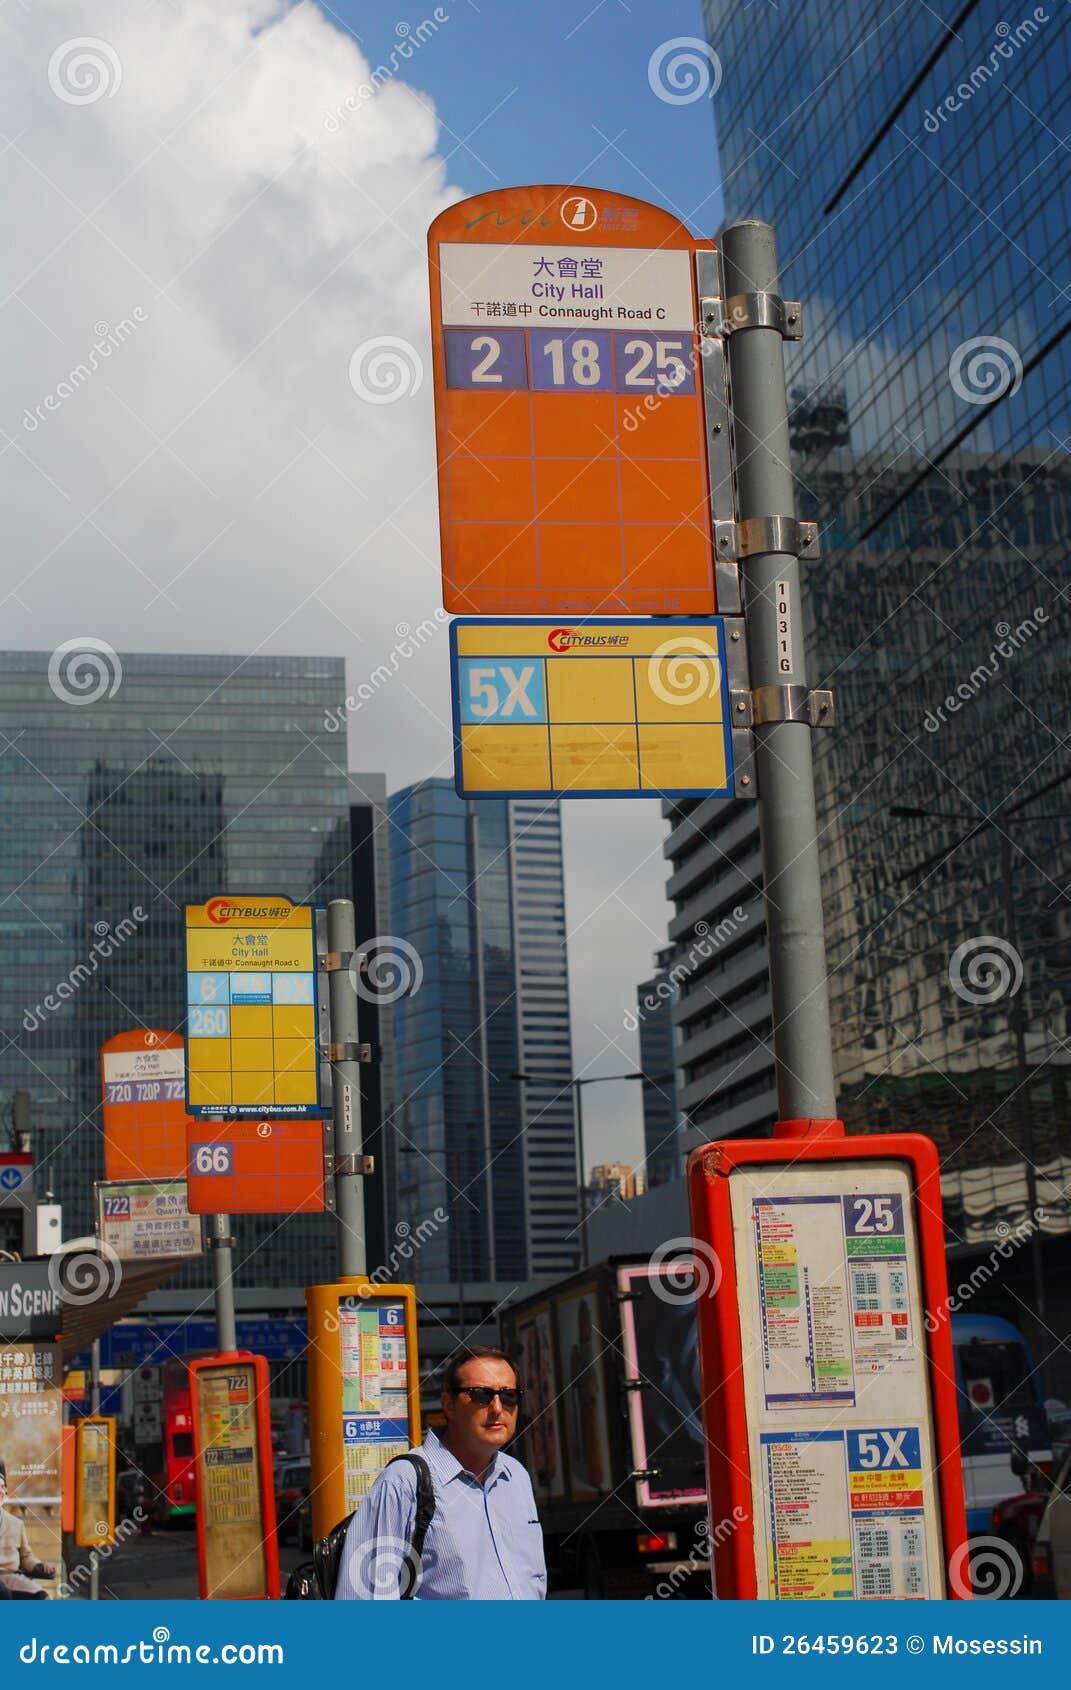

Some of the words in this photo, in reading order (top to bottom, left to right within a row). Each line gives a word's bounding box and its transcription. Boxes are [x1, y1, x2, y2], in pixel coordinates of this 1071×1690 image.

[533, 256, 603, 279] 大會堂
[531, 282, 565, 301] City
[571, 283, 604, 299] Hall
[470, 302, 532, 318] 干諾道中
[538, 304, 613, 321] Connaught
[617, 307, 652, 319] Road
[656, 308, 666, 320] C
[470, 336, 503, 383] 2
[543, 338, 601, 386] 18
[624, 339, 686, 387] 25
[560, 636, 607, 645] CITYBUS
[468, 667, 538, 716] 5X
[219, 907, 268, 917] CITYBUS
[232, 934, 268, 946] 大會堂
[231, 947, 249, 958] City
[251, 946, 269, 956] Hall
[274, 958, 292, 967] Road
[201, 976, 216, 1000] 6
[276, 975, 310, 1000] 6X
[191, 1009, 227, 1035] 260
[108, 1084, 132, 1103] 720
[137, 1082, 161, 1101] 720P
[196, 1146, 229, 1173] 66
[105, 1198, 129, 1215] 722
[853, 1198, 895, 1233] 25
[386, 1309, 398, 1325] 6
[230, 1376, 248, 1390] 722
[346, 1421, 357, 1438] 6
[858, 1431, 910, 1468] 5X
